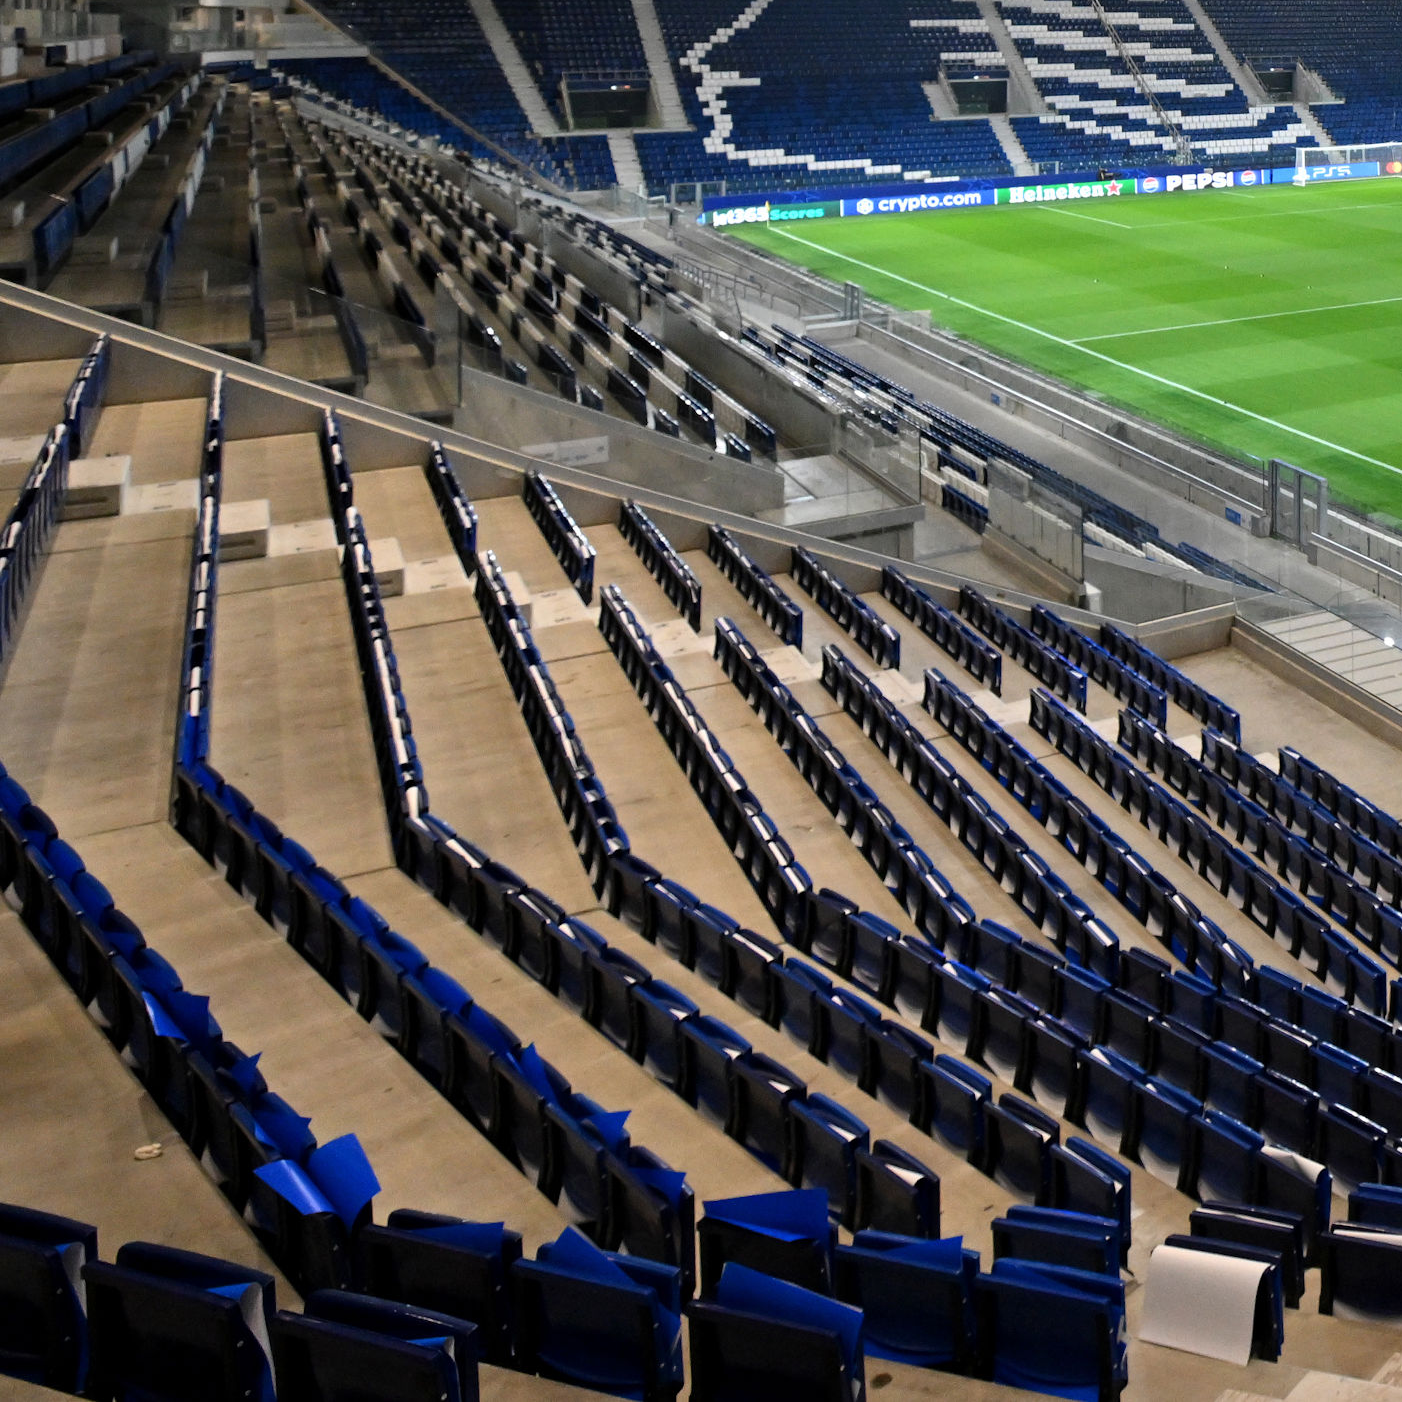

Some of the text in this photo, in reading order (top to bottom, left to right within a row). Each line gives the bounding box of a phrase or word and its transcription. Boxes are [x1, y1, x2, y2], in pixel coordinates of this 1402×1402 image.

[1166, 171, 1234, 192] PEPSI
[1313, 166, 1351, 179] PS5
[878, 192, 982, 212] crypto.com
[1009, 182, 1104, 204] Heineken
[769, 208, 825, 221] Scores
